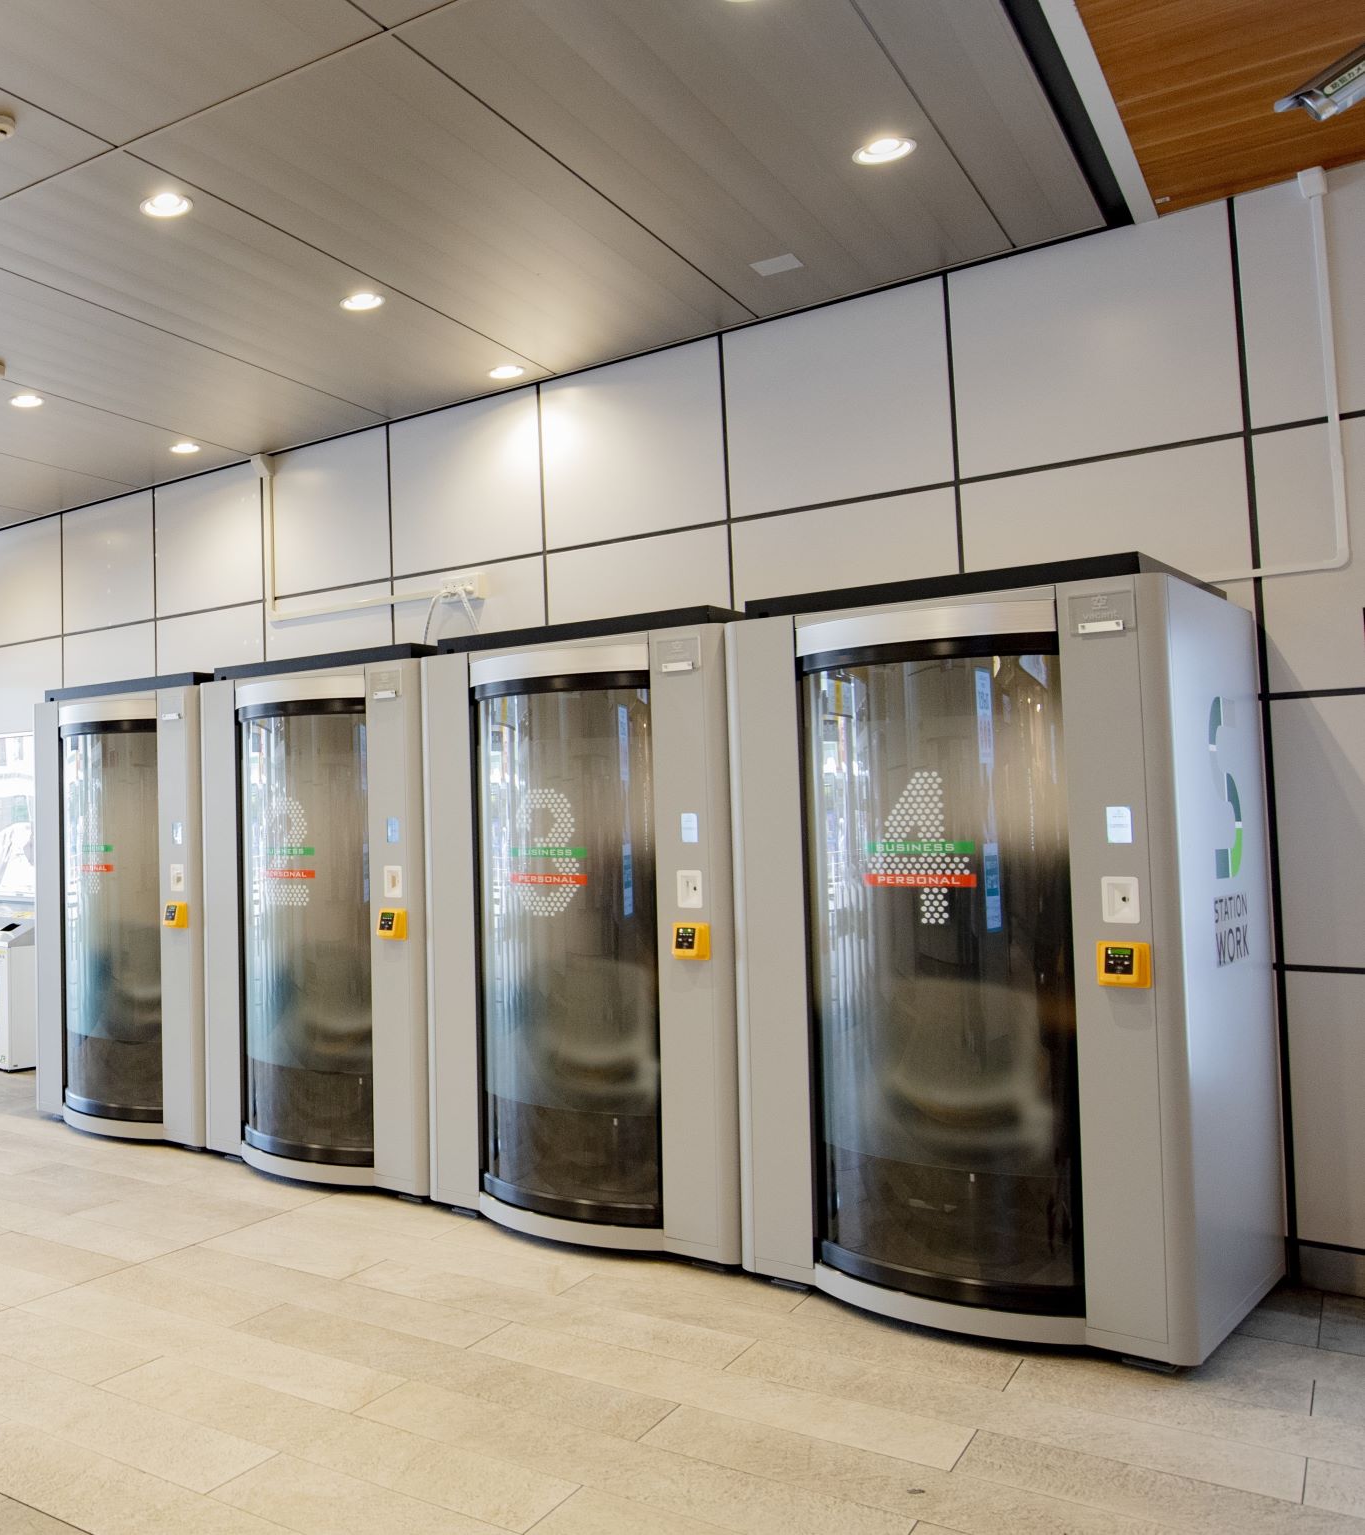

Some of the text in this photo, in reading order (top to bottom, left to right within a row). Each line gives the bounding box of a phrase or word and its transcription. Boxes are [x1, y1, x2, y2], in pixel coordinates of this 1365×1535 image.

[875, 843, 955, 852] BUSINESS
[877, 876, 961, 885] PERSONAL
[1214, 894, 1247, 923] STATION
[1216, 925, 1249, 966] WORK
